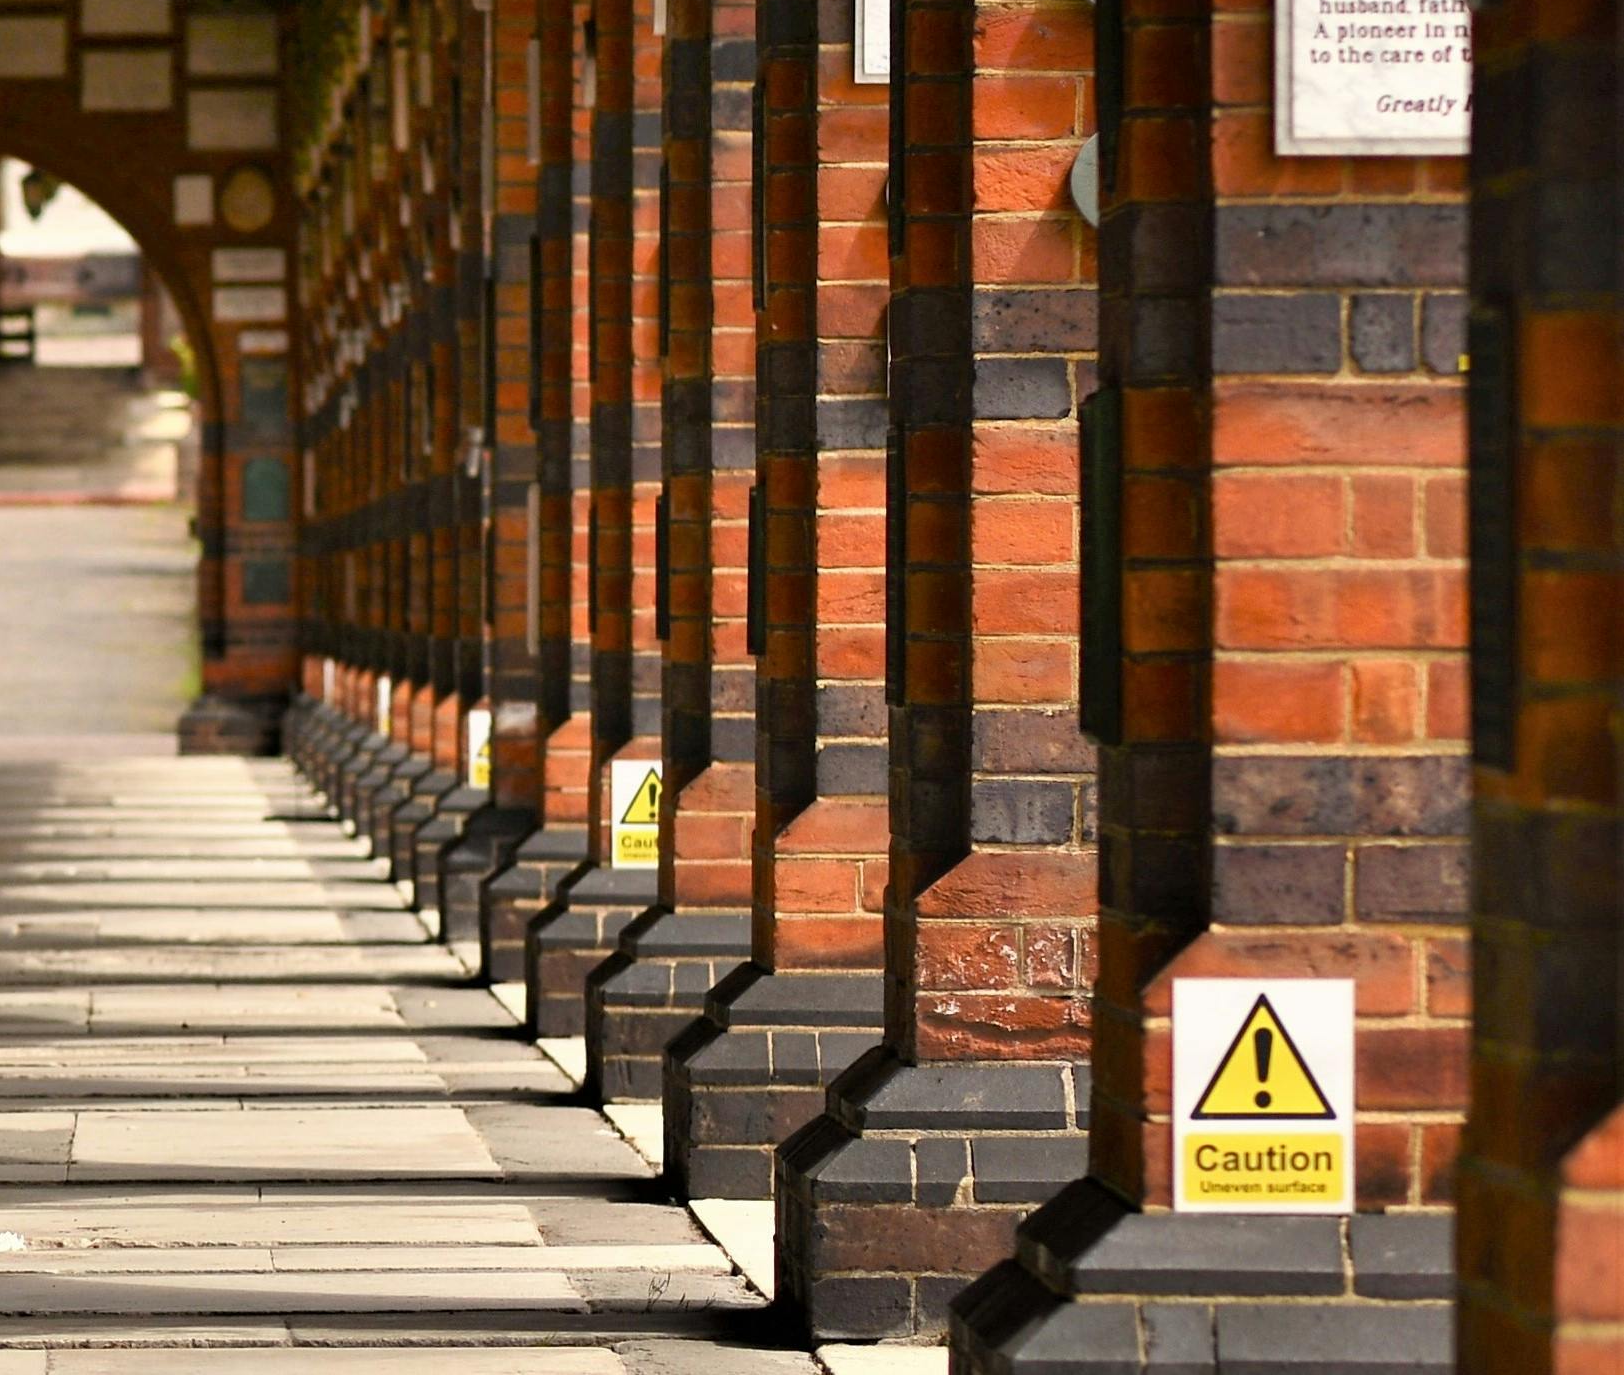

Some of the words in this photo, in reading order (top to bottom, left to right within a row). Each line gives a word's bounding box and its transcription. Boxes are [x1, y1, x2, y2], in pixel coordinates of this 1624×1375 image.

[1313, 22, 1330, 39] A
[1337, 23, 1417, 43] pioneer
[1425, 22, 1446, 39] in
[1309, 47, 1331, 64] to
[1338, 45, 1375, 64] the
[1379, 48, 1425, 64] care
[1432, 44, 1453, 64] of
[1376, 93, 1457, 116] Greatly
[1194, 1143, 1333, 1172] Caution
[1200, 1181, 1262, 1194] Uneven
[1267, 1180, 1327, 1194] surface
